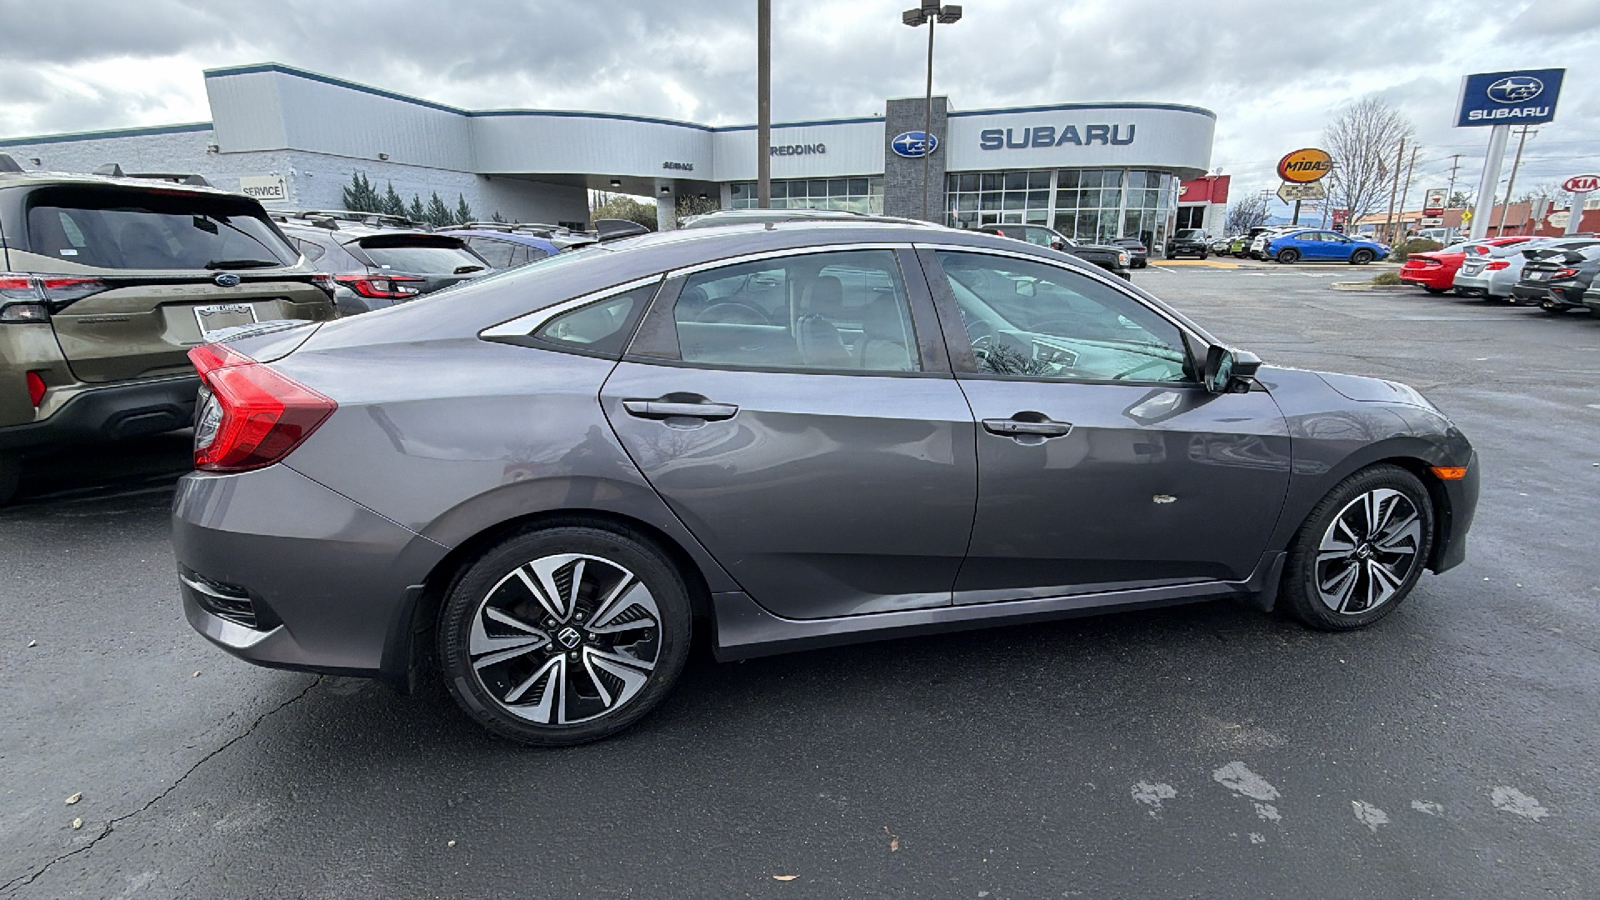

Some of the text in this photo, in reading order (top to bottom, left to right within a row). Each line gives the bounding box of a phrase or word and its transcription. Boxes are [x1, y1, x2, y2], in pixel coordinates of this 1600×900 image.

[1468, 106, 1549, 121] SUBARU
[980, 124, 1136, 150] SUBARU
[770, 143, 826, 156] REDDING
[1284, 160, 1330, 172] MIDAS
[1571, 178, 1598, 189] KIA
[242, 186, 281, 197] SERVICE
